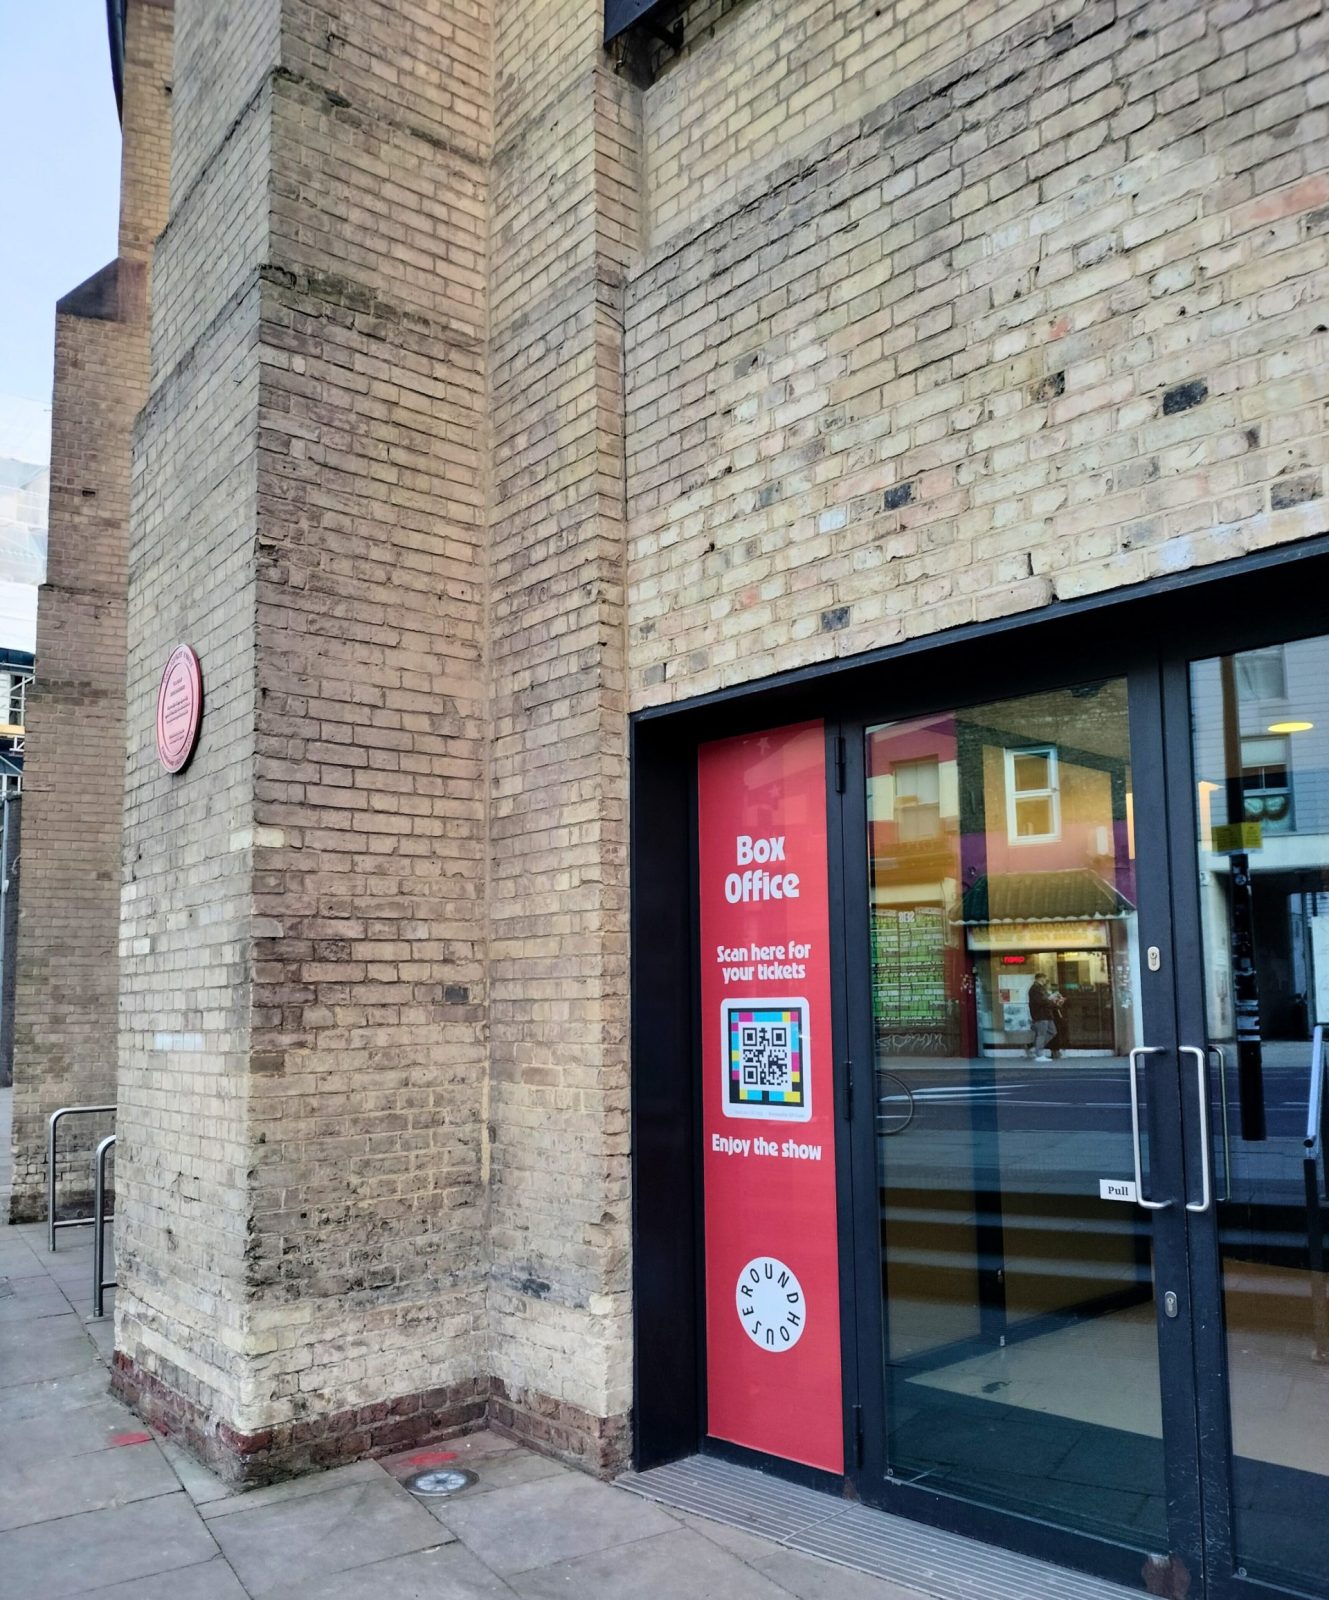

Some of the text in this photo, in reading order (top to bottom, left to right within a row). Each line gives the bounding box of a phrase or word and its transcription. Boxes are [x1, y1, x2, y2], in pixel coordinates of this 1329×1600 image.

[736, 835, 786, 866] Box
[724, 868, 800, 903] Office
[716, 940, 812, 963] Scan here for
[722, 961, 806, 984] your tickets
[711, 1133, 822, 1161] Enjoy the show
[1108, 1186, 1129, 1196] Pull
